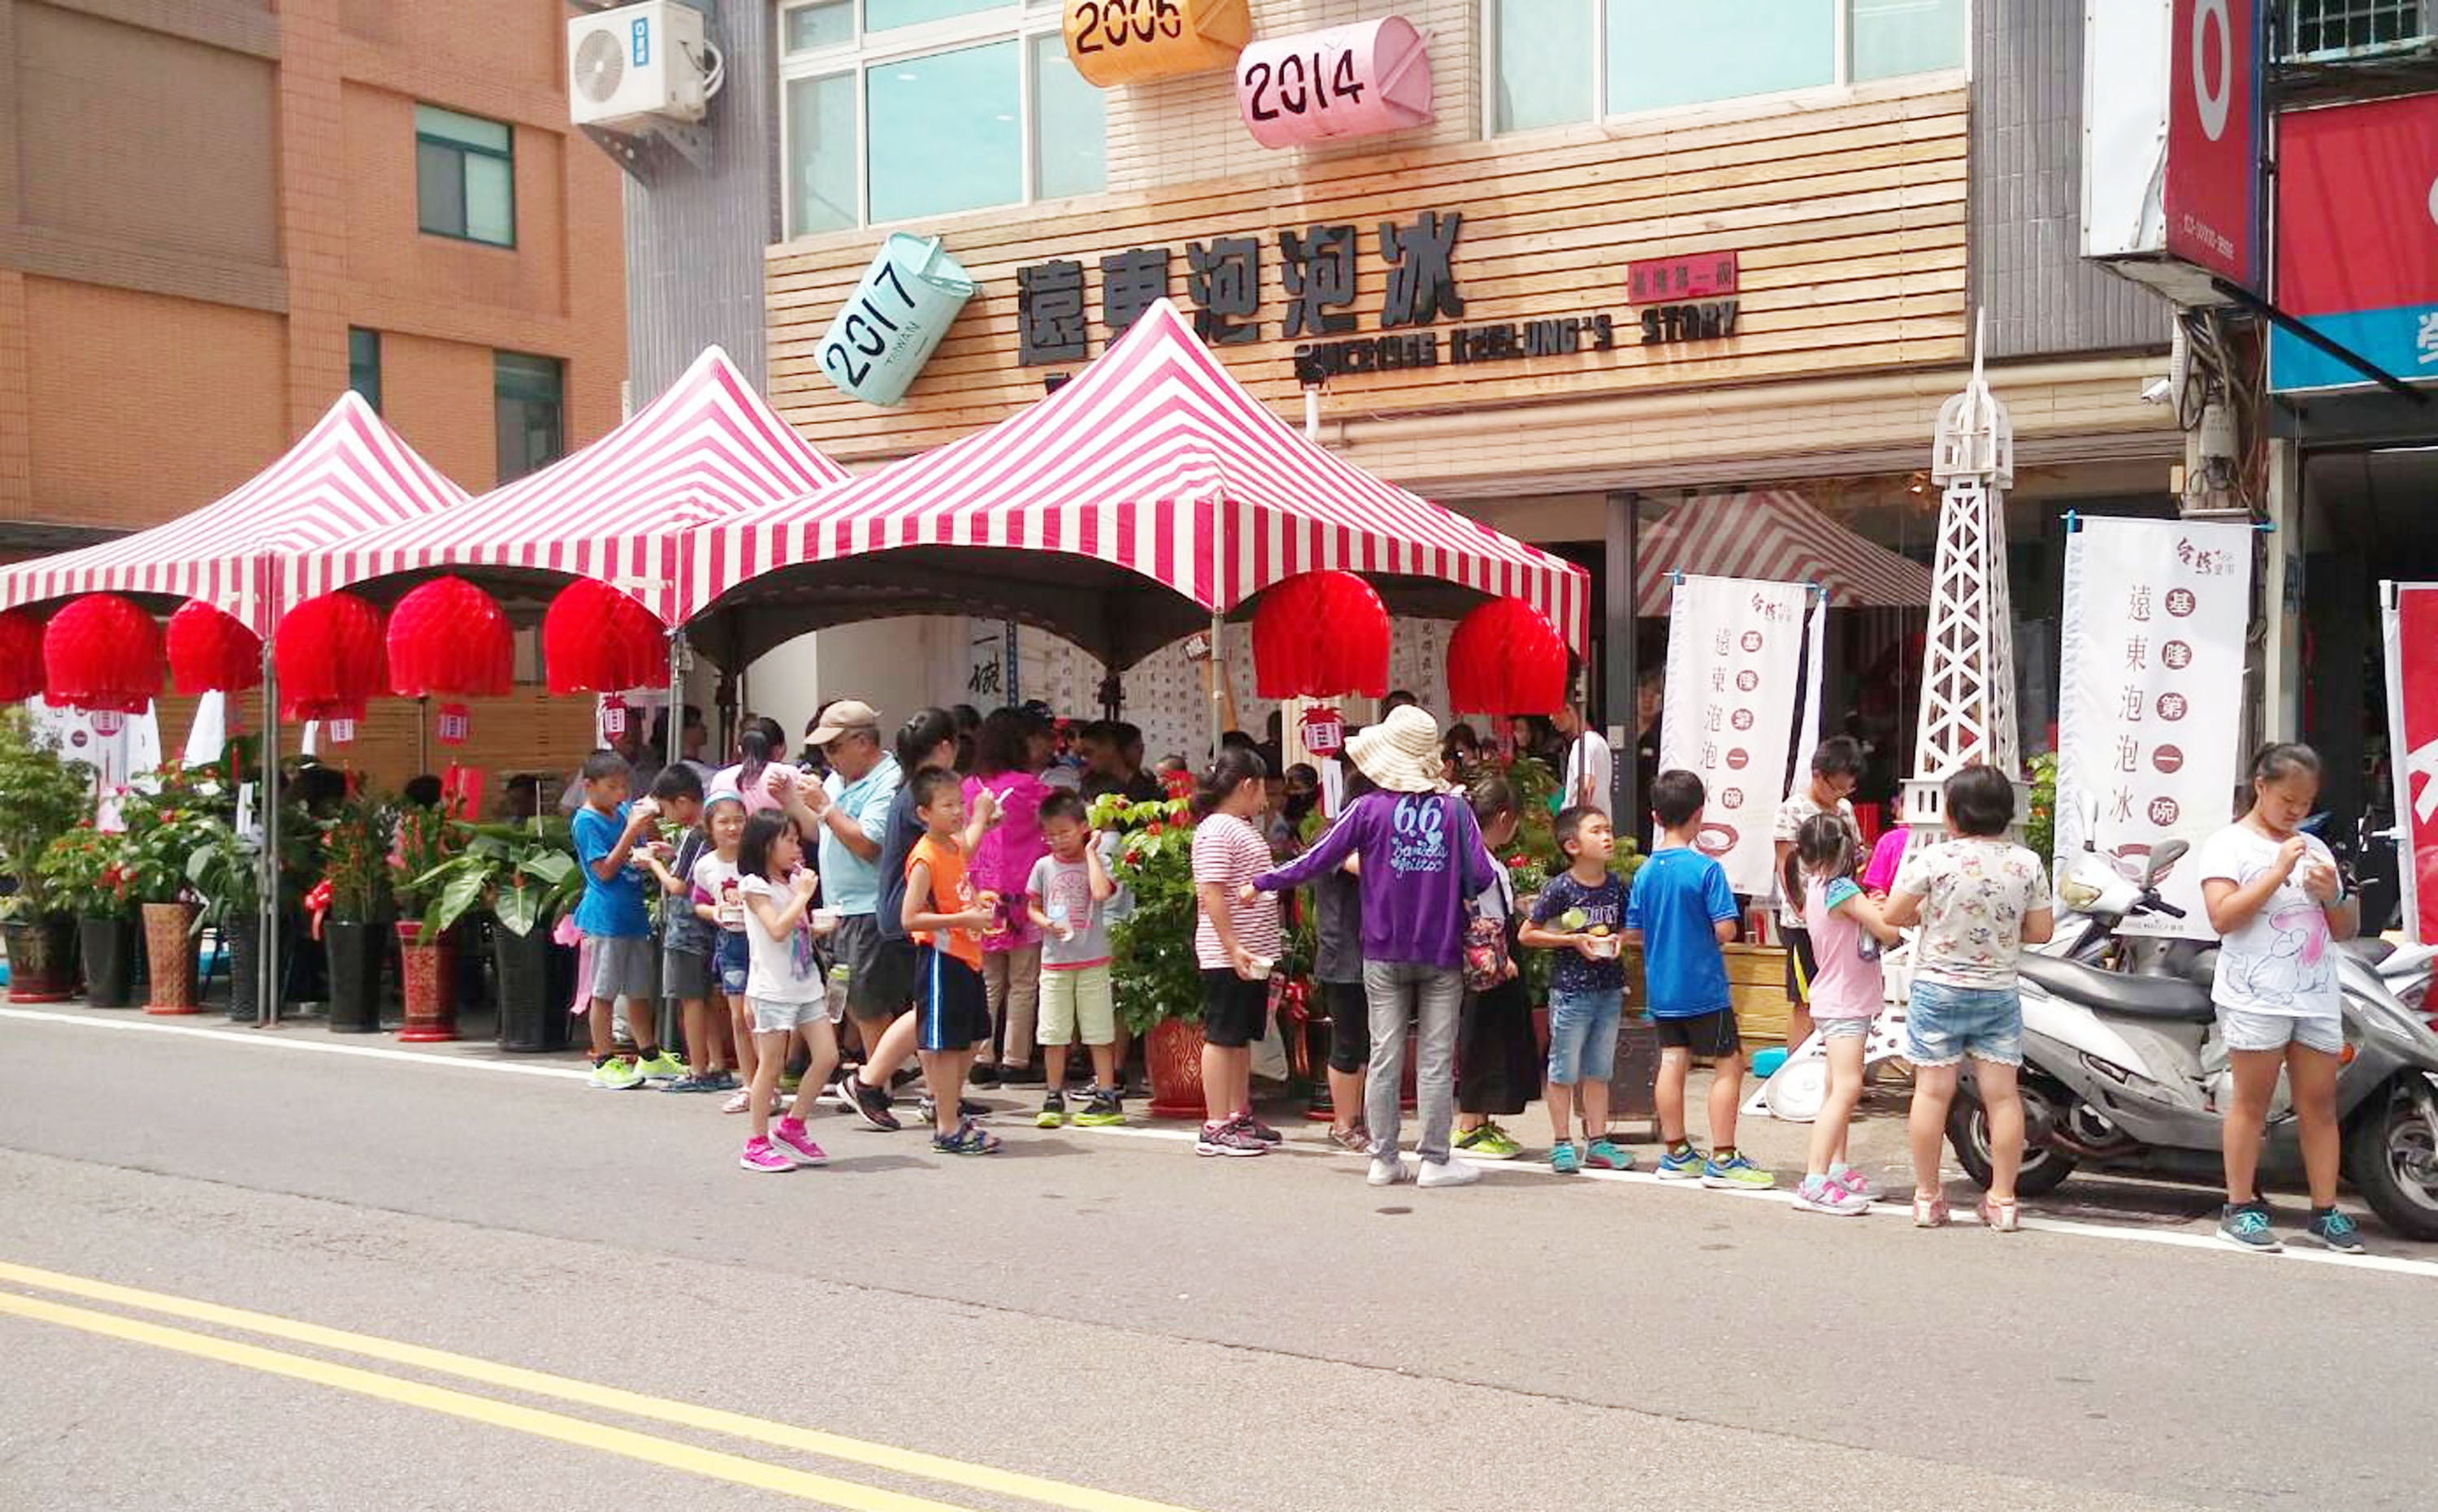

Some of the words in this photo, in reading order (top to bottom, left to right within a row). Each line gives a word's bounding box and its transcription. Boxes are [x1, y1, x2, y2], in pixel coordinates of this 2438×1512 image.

[1245, 49, 1364, 121] 2014
[826, 262, 916, 388] 2017
[1017, 211, 1464, 366] 遠東泡泡冰
[1641, 301, 1737, 344] STORY
[2109, 584, 2152, 822] 遠東泡泡冰
[2150, 589, 2194, 825] 基隆第一碗
[1394, 795, 1444, 834] 66
